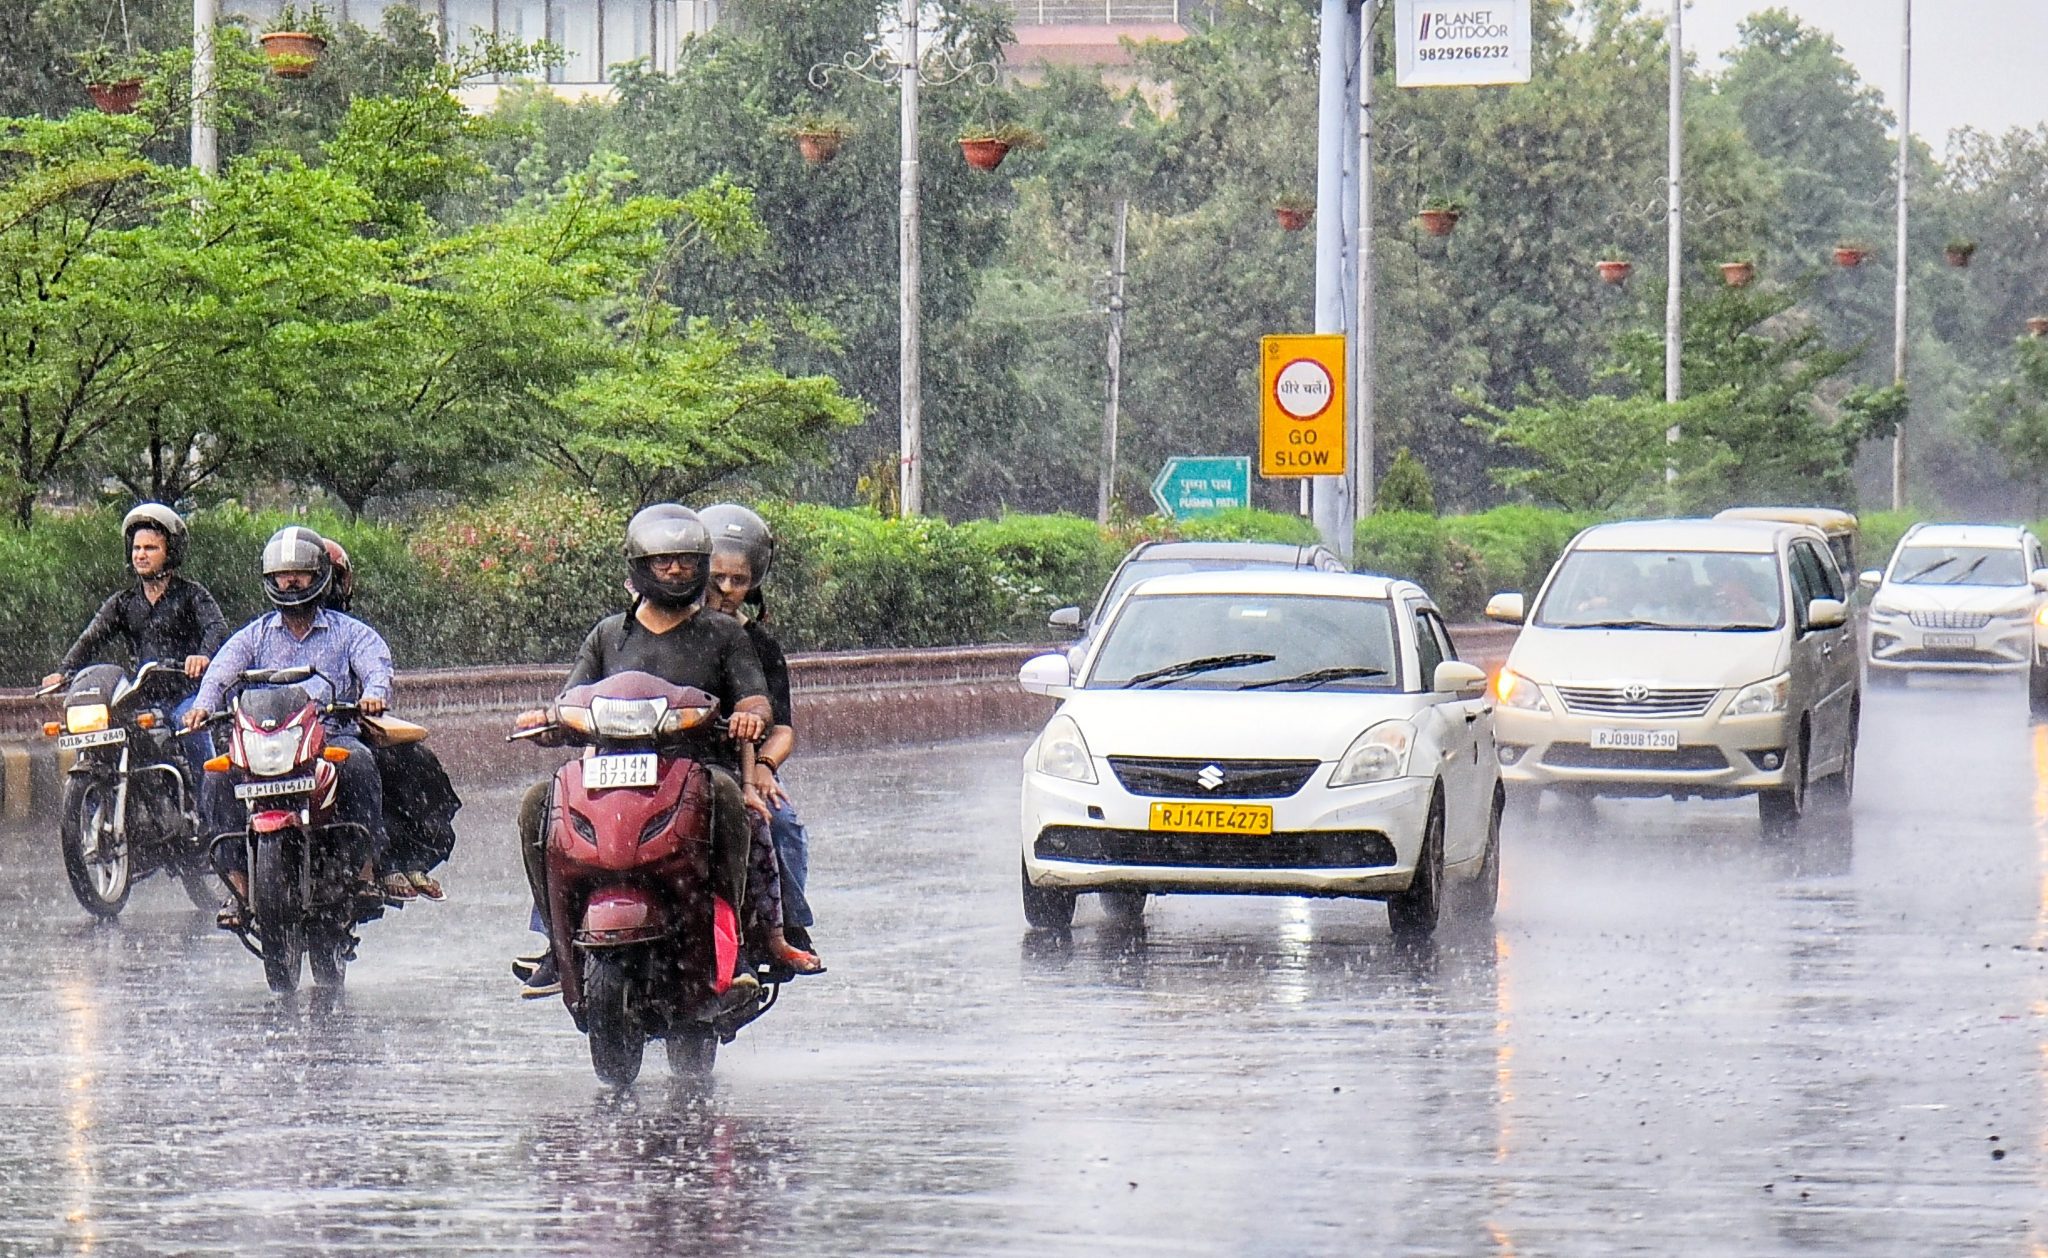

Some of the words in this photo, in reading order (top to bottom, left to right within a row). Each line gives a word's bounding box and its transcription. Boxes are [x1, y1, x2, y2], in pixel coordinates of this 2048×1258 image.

[1435, 11, 1492, 25] PLANET
[1435, 25, 1508, 40] OUTDOOR
[1419, 45, 1509, 61] 9829266232
[1281, 380, 1299, 394] धीरे
[1289, 429, 1317, 445] GO
[1275, 450, 1329, 466] SLOW
[1599, 732, 1675, 746] RJ09UB1290
[600, 757, 648, 771] RJ14N
[1162, 809, 1269, 829] RJ14TE4273
